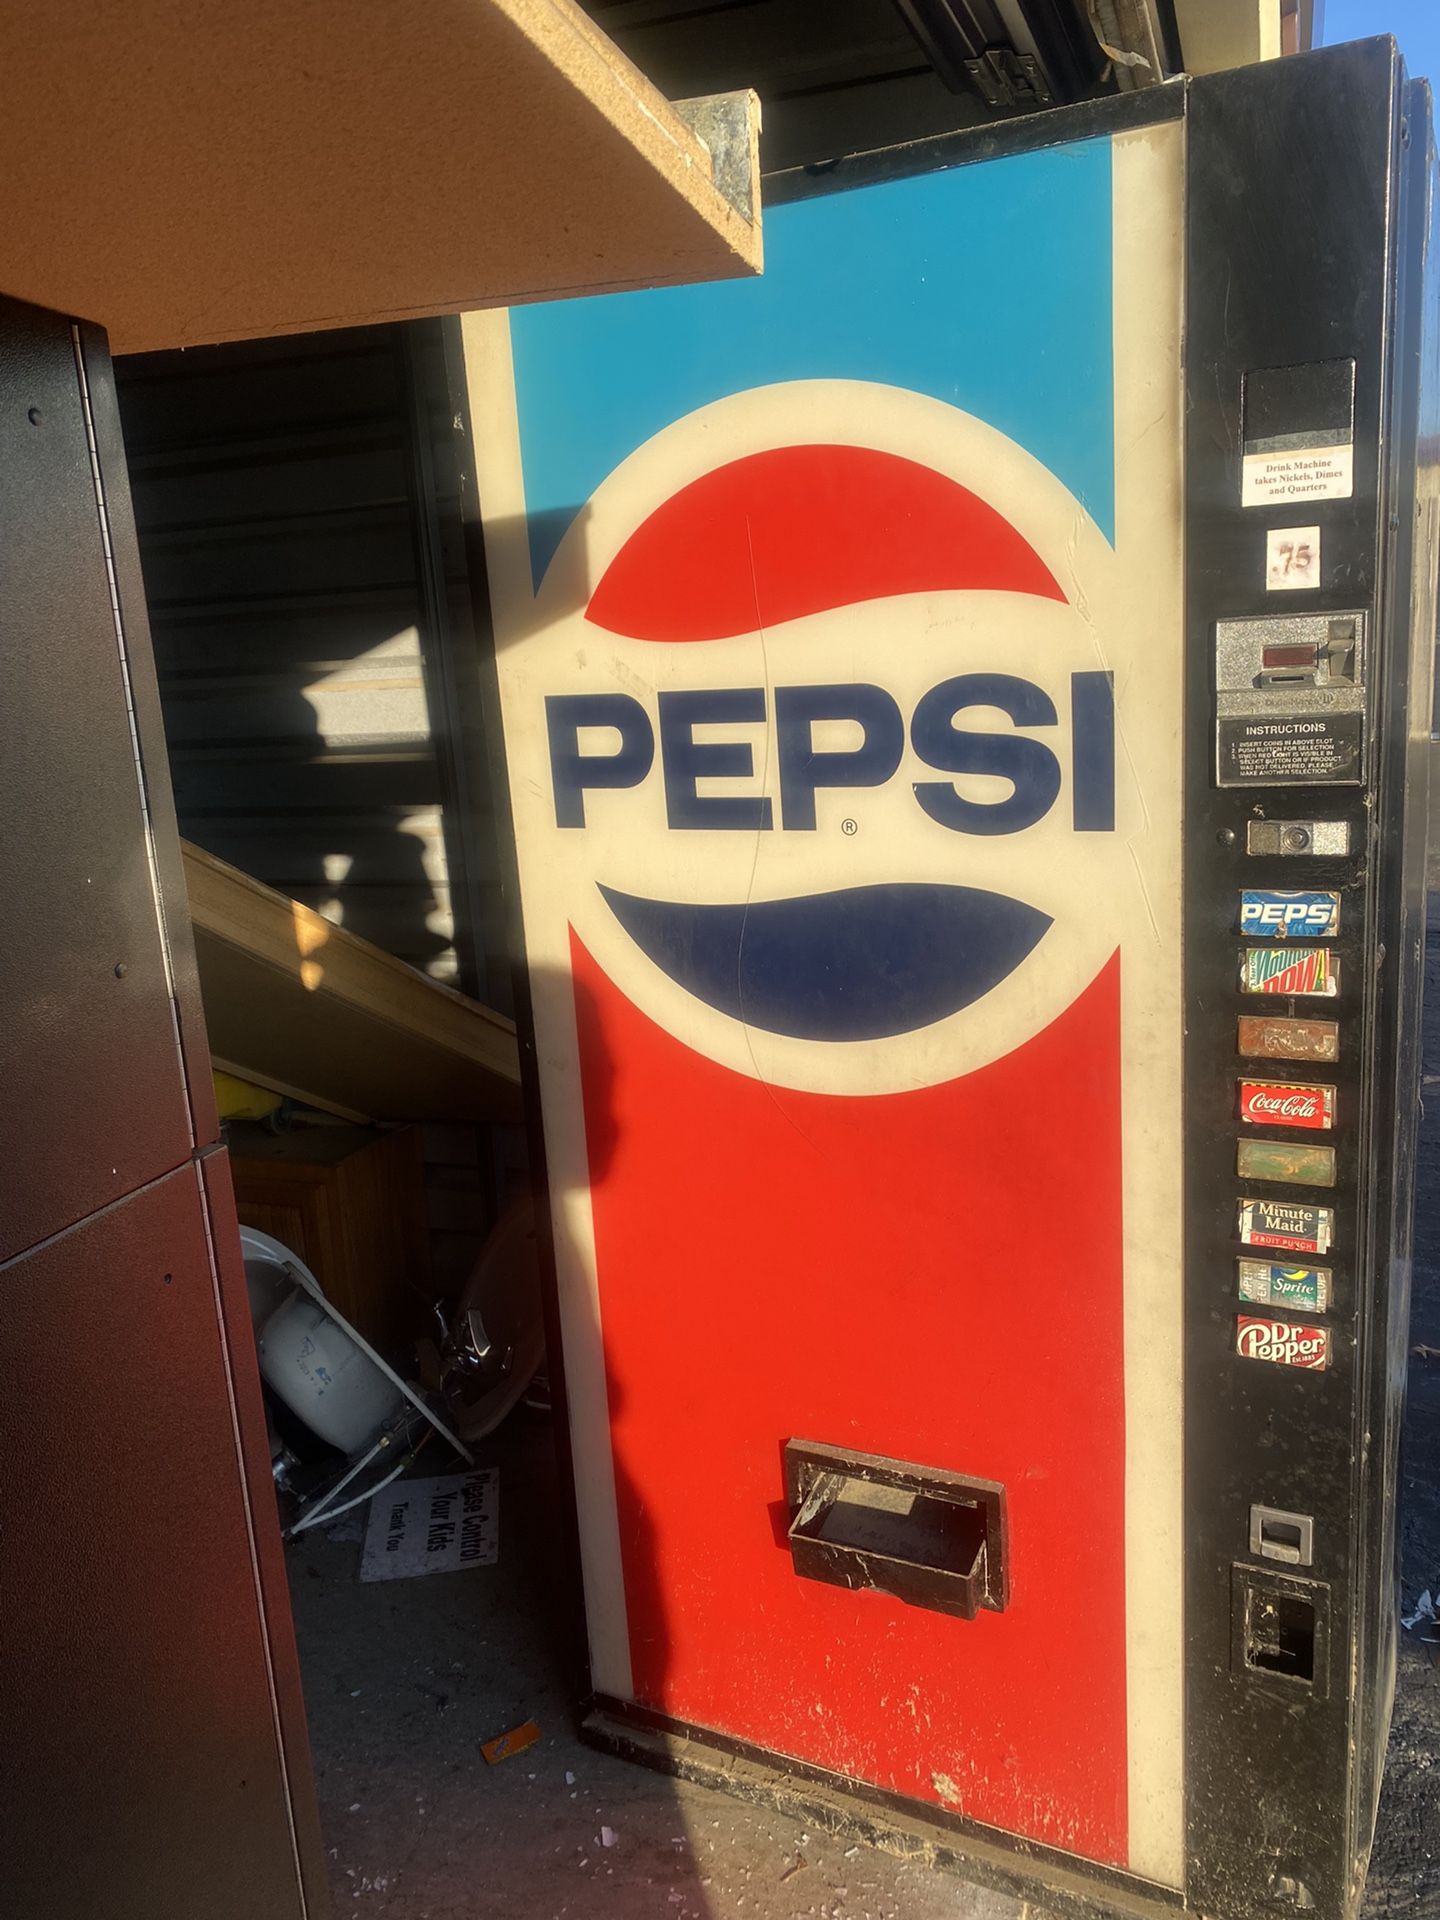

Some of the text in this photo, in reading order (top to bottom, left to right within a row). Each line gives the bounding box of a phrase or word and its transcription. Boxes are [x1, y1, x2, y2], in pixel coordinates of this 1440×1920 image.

[1266, 459, 1332, 473] Drink Machine
[1255, 470, 1343, 485] takes Nickels, Dimes
[1269, 483, 1327, 495] and Quarters
[1246, 723, 1326, 735] INSTRUCTIONS
[544, 670, 1115, 836] PEPSI
[1257, 745, 1282, 753] BUTTON
[1265, 757, 1291, 765] BUTTON
[1259, 1202, 1313, 1221] Minute
[1265, 1216, 1305, 1233] Maid
[1254, 1235, 1313, 1250] FRUIT PUNCH
[1273, 1277, 1314, 1294] Sprite
[1271, 1322, 1303, 1344] Dr
[1238, 1324, 1325, 1364] Pepper
[427, 1491, 458, 1552] Your Kids
[460, 1472, 491, 1562] Please Control
[387, 1502, 409, 1552] Thank You
